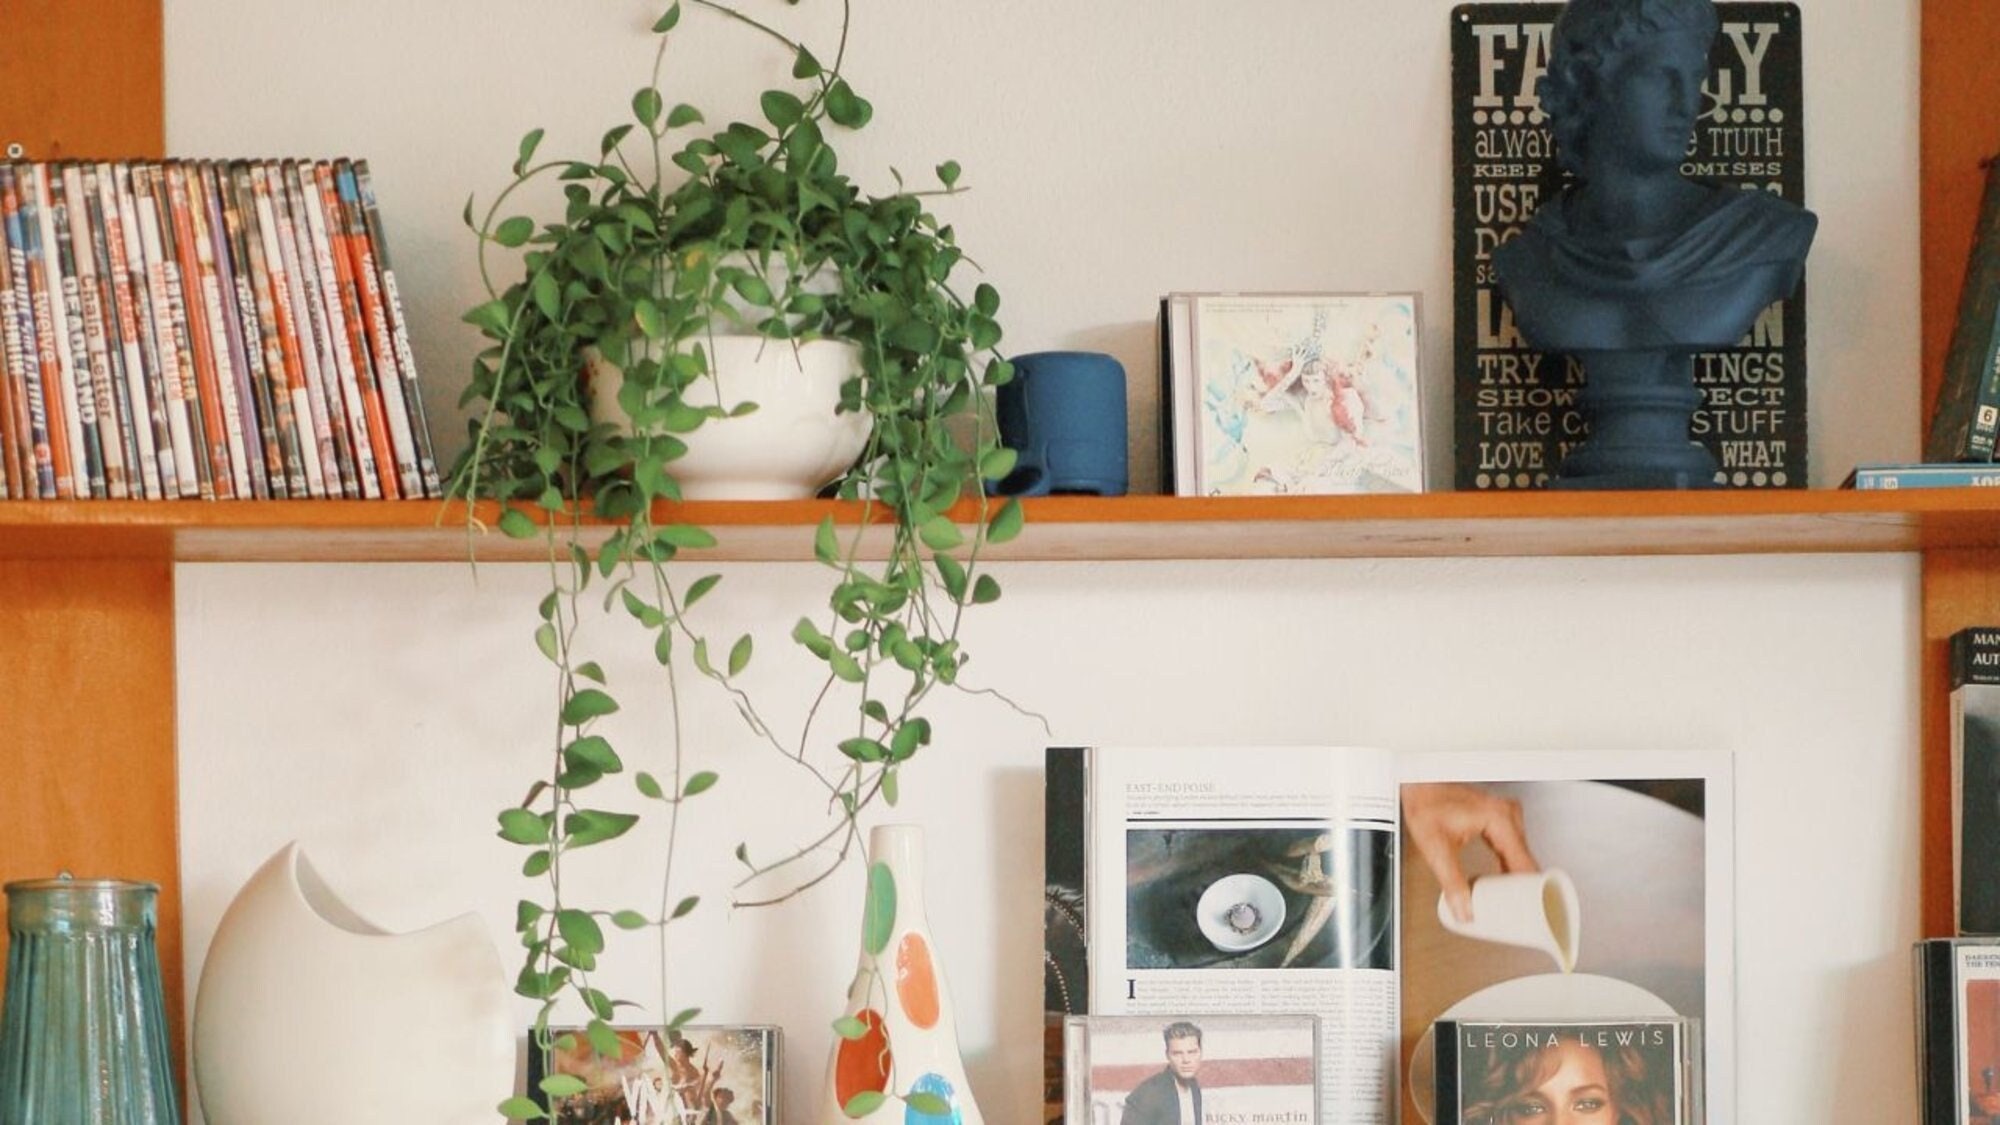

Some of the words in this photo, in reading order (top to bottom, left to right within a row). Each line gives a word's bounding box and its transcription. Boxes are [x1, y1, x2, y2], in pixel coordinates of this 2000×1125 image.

[1471, 22, 1780, 107] FAY
[1475, 128, 1559, 158] aLWaY
[1474, 163, 1542, 178] KEEP
[1680, 162, 1782, 176] OMISES
[1474, 184, 1539, 223] USE
[33, 291, 55, 362] twelve
[63, 275, 96, 423] DEADLAND
[81, 273, 100, 338] Chain
[91, 351, 112, 418] Letter
[1477, 353, 1541, 384] TRY
[1689, 352, 1785, 384] INGS
[1477, 388, 1578, 407] SHOW
[1478, 411, 1551, 435] Take
[1691, 410, 1786, 434] STUFF
[1479, 441, 1544, 470] LOVE
[1720, 440, 1787, 468] WHAT
[1466, 1031, 1560, 1049] LEONA
[1580, 1030, 1665, 1048] LEWIS
